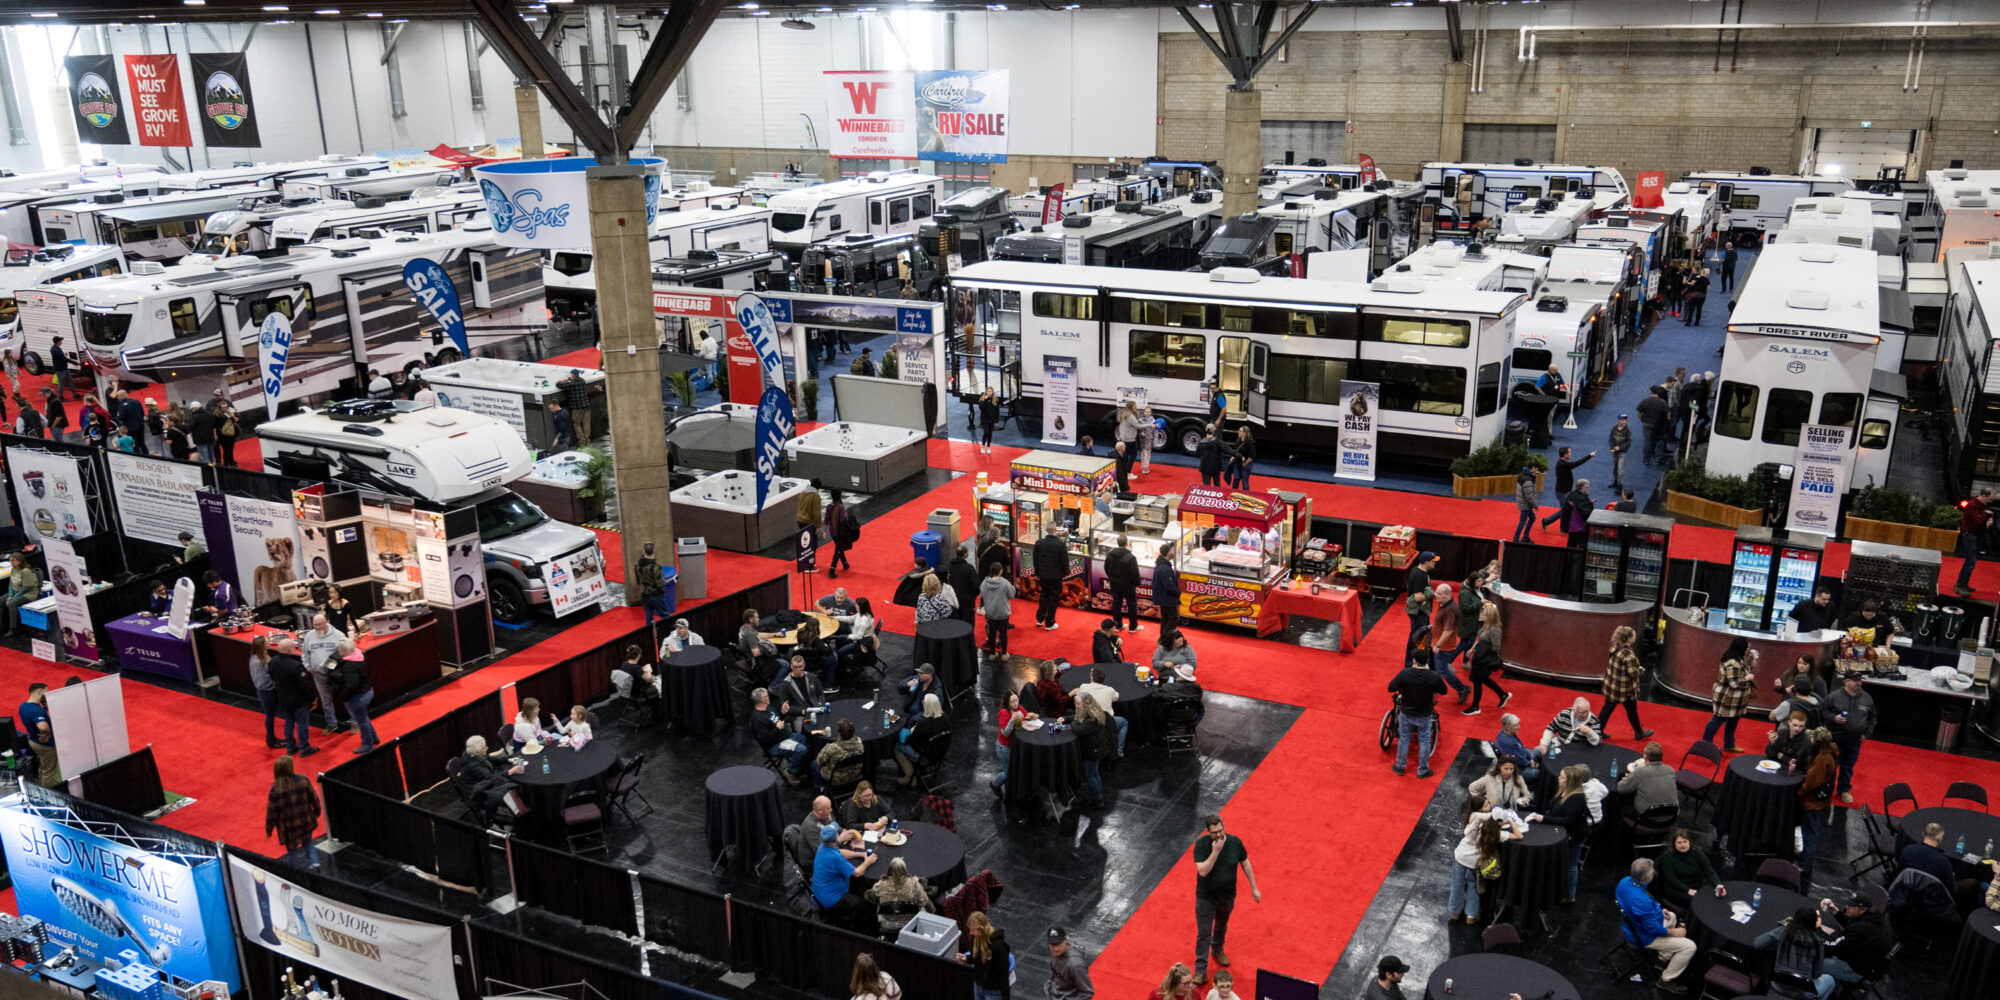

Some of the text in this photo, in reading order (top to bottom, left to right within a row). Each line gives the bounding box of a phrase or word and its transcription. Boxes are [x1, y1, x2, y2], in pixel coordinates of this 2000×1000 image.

[131, 63, 156, 78] YOU
[137, 79, 166, 93] MUST
[926, 84, 965, 97] Carefree
[140, 94, 159, 108] SEE
[142, 108, 179, 122] GROVE
[207, 102, 234, 117] GROVE
[145, 123, 165, 137] RV!
[837, 118, 906, 133] WINNEBAGO
[938, 112, 1005, 136] RV SALE
[487, 198, 516, 217] ORLD
[512, 188, 570, 239] Spas
[406, 271, 460, 331] SALE
[653, 293, 712, 311] INNEBAGO
[738, 307, 782, 373] SALE
[1040, 329, 1080, 339] SALEM
[1758, 326, 1849, 340] FOREST RIVER
[905, 351, 919, 361] RV
[1768, 344, 1829, 357] SALEM
[266, 327, 291, 397] SALE
[905, 362, 928, 370] SERVICE
[904, 375, 929, 384] FINANCE
[907, 369, 926, 377] PARTS
[1344, 413, 1371, 423] WE PAY
[1344, 421, 1371, 431] CASH
[1807, 426, 1846, 438] SELLING
[757, 408, 793, 482] SALE
[1807, 435, 1844, 445] YOUR RV?
[135, 461, 174, 475] RESORTS
[1342, 457, 1370, 467] CONSIGN
[386, 464, 417, 476] LANCE
[115, 471, 156, 487] CANADIAN
[156, 479, 198, 493] BADLANDS
[482, 478, 502, 488] LANCE
[1023, 476, 1081, 494] Mini Donuts
[1800, 482, 1834, 494] PAID
[1190, 488, 1224, 498] JUMBO
[1186, 495, 1240, 511] HOTDOGS
[230, 502, 289, 519] Say hello to TELUS
[231, 513, 274, 528] SmartHome
[233, 524, 264, 538] Security.
[1206, 578, 1235, 588] JUMBO
[570, 591, 590, 604] CANADIAN
[1186, 581, 1255, 601] HOTDOGS
[136, 648, 161, 658] TELUS
[26, 857, 41, 869] LOW
[42, 862, 61, 876] FLOW
[130, 892, 180, 919] SHOWERHEAD
[142, 914, 183, 937] FITS ANY
[313, 904, 379, 939] NO MORE
[44, 922, 98, 949] ONVERT Your
[149, 927, 181, 947] SPACE!
[319, 925, 381, 962] BOTOX
